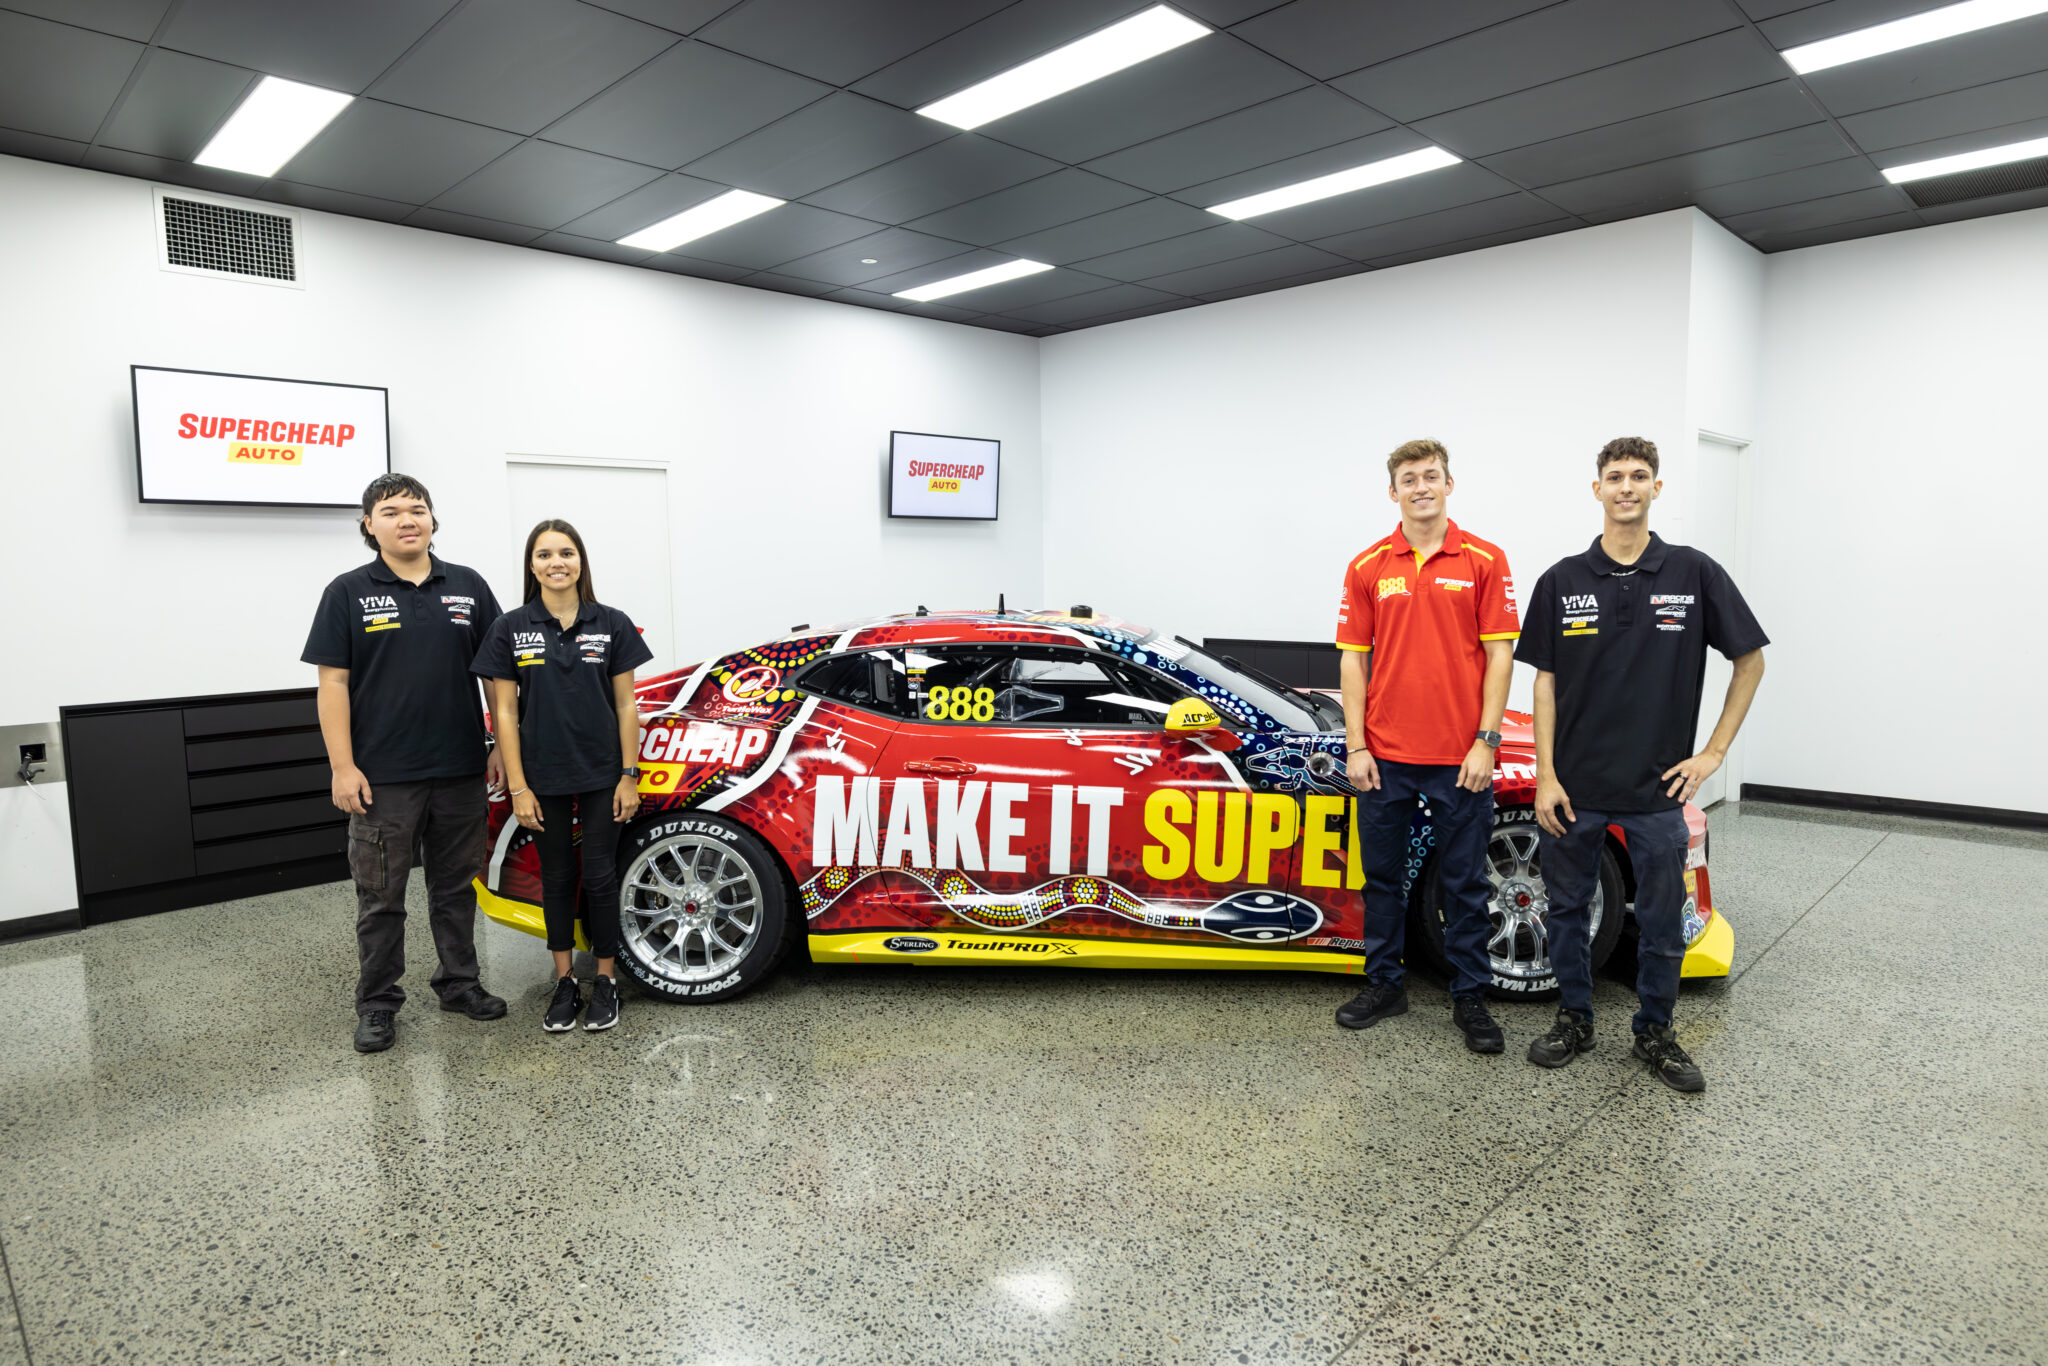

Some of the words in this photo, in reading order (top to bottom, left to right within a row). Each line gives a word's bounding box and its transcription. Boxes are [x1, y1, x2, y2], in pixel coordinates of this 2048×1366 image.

[178, 413, 355, 447] SUPERCHEAP
[235, 447, 295, 461] AUTO
[908, 460, 984, 480] SUPERCHEAP
[931, 481, 957, 489] AUTO
[359, 596, 397, 609] VIVA
[1562, 595, 1598, 609] VIVA
[513, 632, 545, 644] VIVA
[927, 686, 995, 722] 888
[650, 821, 738, 841] DUNLOP
[812, 775, 1028, 873] MAKE
[1049, 784, 1124, 877] IT
[889, 938, 935, 949] SPERLING
[1330, 937, 1365, 949] Repco
[643, 973, 690, 996] MAXX
[692, 970, 741, 996] SPORT
